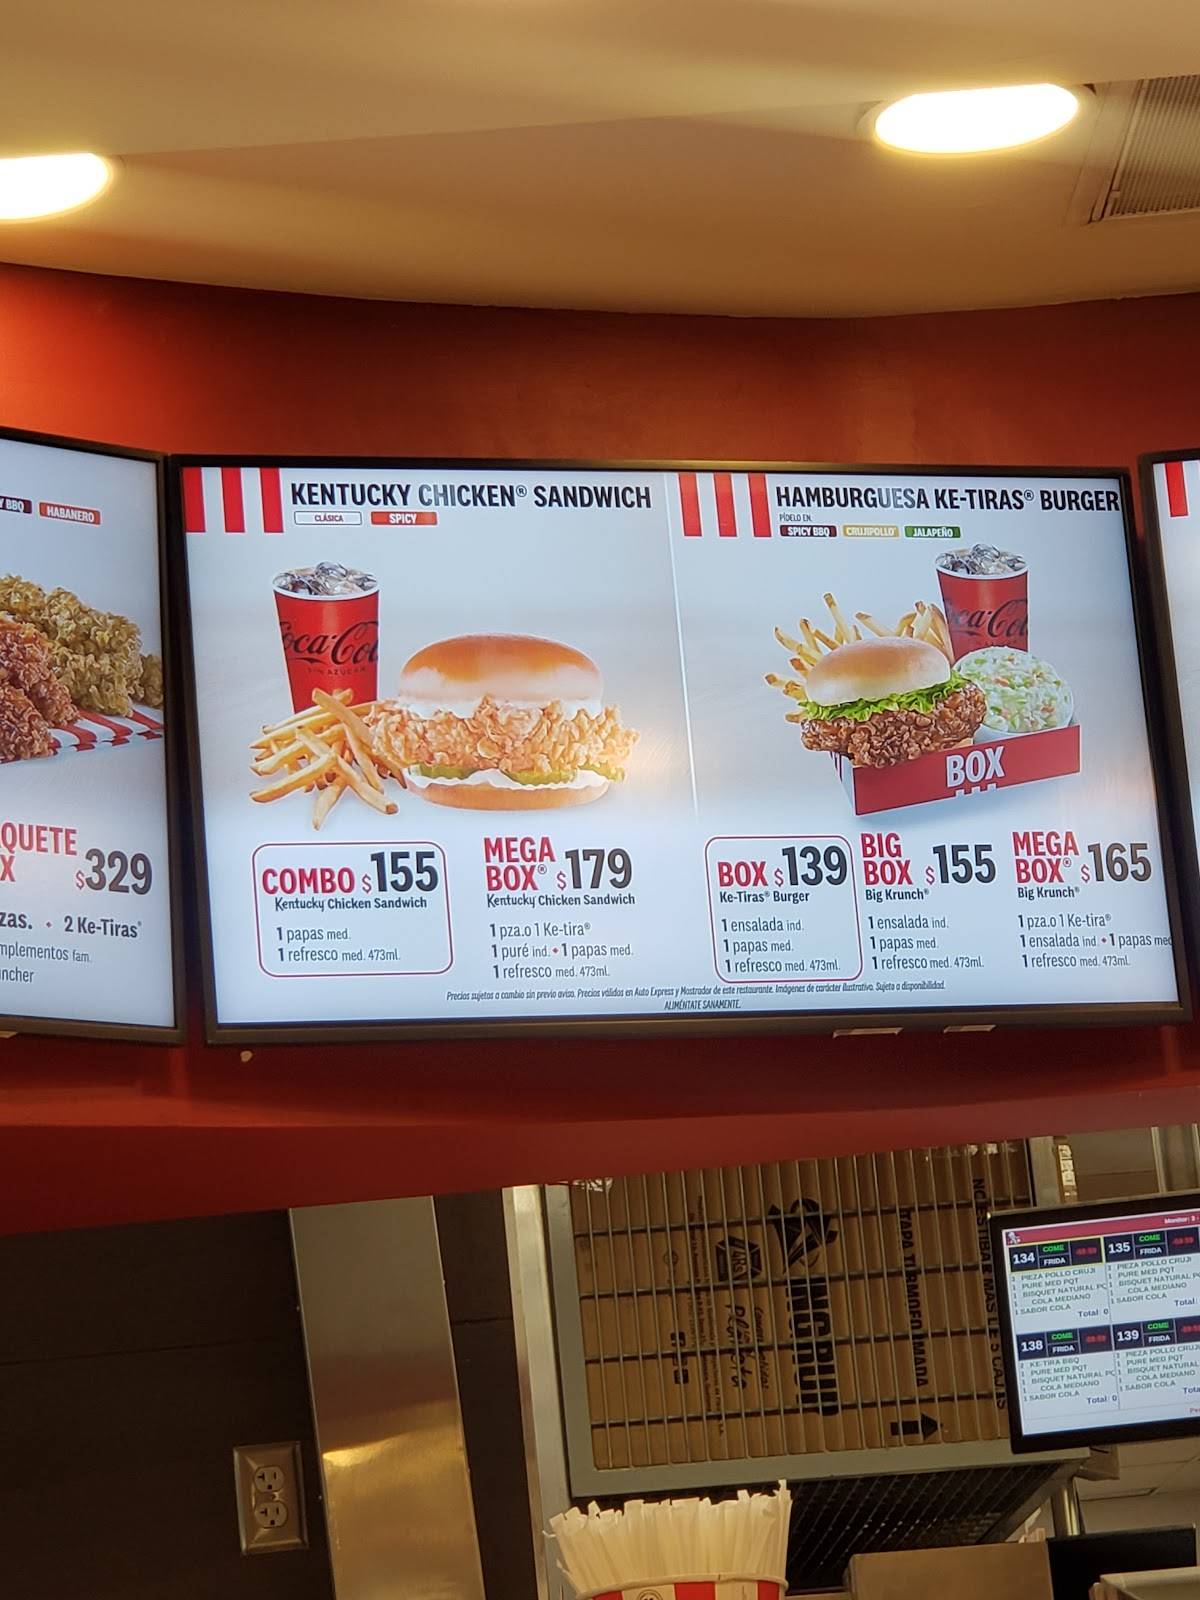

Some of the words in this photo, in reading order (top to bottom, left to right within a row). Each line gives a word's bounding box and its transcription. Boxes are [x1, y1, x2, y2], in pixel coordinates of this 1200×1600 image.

[291, 483, 411, 506] KENTUCKY
[533, 485, 652, 509] SANDWICH
[776, 486, 930, 509] HAMBURGUESA
[1040, 489, 1120, 512] BURGER
[6, 498, 24, 512] BBQ
[46, 505, 95, 523] HABANERO
[314, 512, 344, 522] CLÁSICA
[388, 512, 417, 525] SPICY
[787, 526, 812, 536] SPICY
[813, 526, 830, 537] BBQ
[912, 526, 953, 538] JALAPEÑO
[946, 745, 1005, 787] BOX
[0, 822, 77, 856] QUETE
[860, 833, 902, 858] BIG
[1012, 831, 1079, 856] MEGA
[484, 836, 556, 863] MEGA
[556, 848, 633, 891] $179
[717, 861, 768, 887] BOX
[774, 845, 848, 887] $139
[863, 860, 913, 886] BOX
[925, 844, 996, 885] $155
[1081, 843, 1152, 883] $165
[76, 848, 152, 895] $329
[262, 867, 355, 895] COMBO
[361, 850, 439, 894] $155
[487, 893, 535, 908] Kentucky
[538, 894, 581, 906] Chicken
[583, 893, 635, 905] Sandwich
[773, 891, 810, 904] Burger
[865, 889, 883, 903] Big
[1018, 887, 1034, 900] Big
[275, 897, 325, 912] Kentucky
[327, 897, 371, 909] Chicken
[374, 896, 427, 909] Sandwich
[0, 911, 33, 930] zas.
[64, 915, 74, 932] 2
[721, 919, 728, 932] 1
[731, 917, 784, 932] ensalada
[868, 916, 874, 929] 1
[877, 914, 928, 929] ensalada
[1018, 915, 1024, 928] 1
[1059, 914, 1064, 927] 1
[276, 927, 283, 941] 1
[287, 928, 324, 944] papas
[490, 924, 496, 937] 1
[534, 923, 540, 936] 1
[724, 939, 729, 952] 1
[733, 940, 768, 955] papas
[870, 936, 876, 949] 1
[880, 938, 914, 952] papas
[1020, 934, 1026, 947] 1
[1029, 932, 1079, 947] ensalada
[1109, 933, 1115, 946] 1
[1118, 935, 1152, 949] papas
[0, 940, 69, 961] mplementos
[278, 948, 284, 962] 1
[288, 946, 338, 961] refresco
[492, 945, 498, 958] 1
[501, 943, 529, 961] puré
[561, 943, 568, 957] 1
[571, 945, 607, 960] papas
[726, 960, 731, 973] 1
[735, 958, 782, 972] refresco
[872, 957, 878, 969] 1
[881, 955, 927, 969] refresco
[1022, 954, 1028, 968] 1
[1031, 953, 1076, 967] refresco
[493, 965, 499, 979] 1
[503, 963, 552, 978] refresco
[447, 991, 470, 1000] Precios
[501, 990, 525, 999] cambio
[526, 990, 535, 999] sin
[536, 990, 556, 1000] previo
[577, 989, 600, 998] Precios
[634, 986, 649, 996] Auto
[651, 986, 674, 997] Express
[680, 985, 712, 995] Mostrador
[713, 985, 721, 995] de
[722, 986, 735, 994] este
[806, 984, 814, 992] de
[1108, 1242, 1131, 1254] 135
[1013, 1253, 1035, 1265] 134
[1117, 1330, 1139, 1342] 139
[1021, 1340, 1043, 1352] 138
